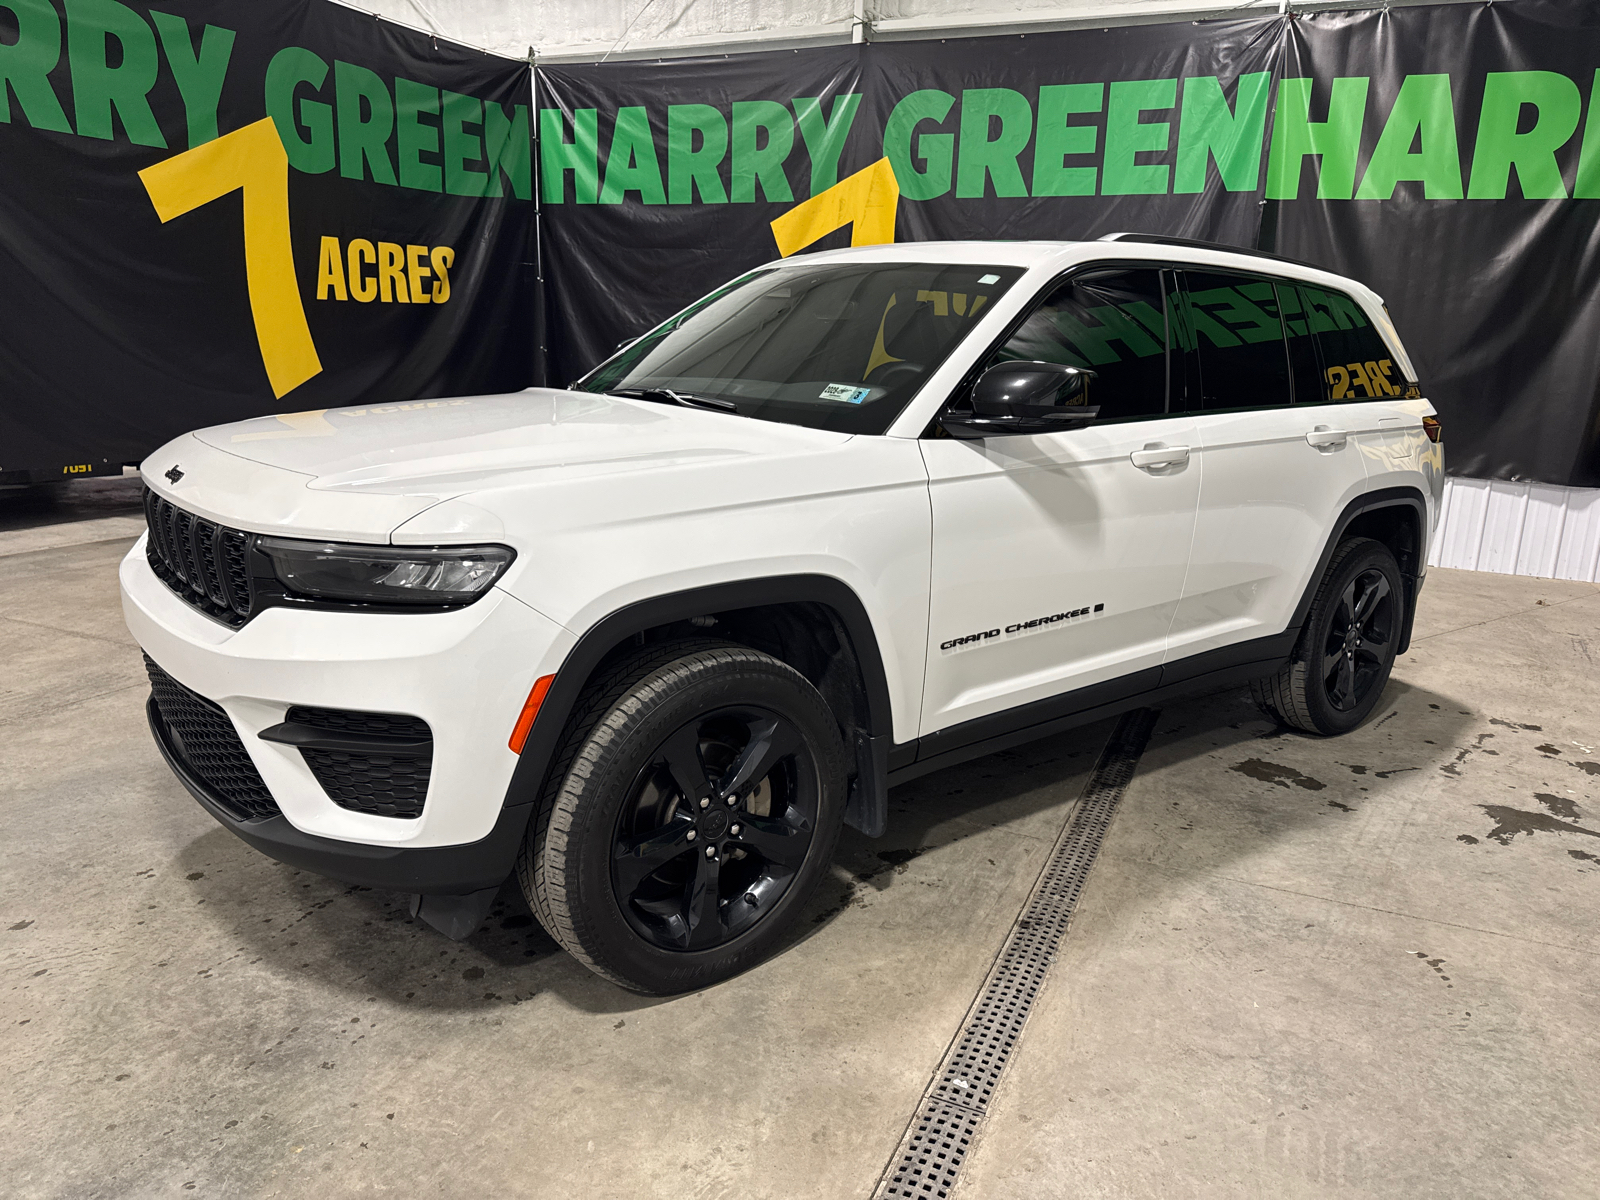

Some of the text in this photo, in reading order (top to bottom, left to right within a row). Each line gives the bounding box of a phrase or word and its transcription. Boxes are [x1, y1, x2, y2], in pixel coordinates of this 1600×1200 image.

[264, 46, 533, 201] GREEN
[539, 71, 1272, 205] HARRY GREEN
[1264, 68, 1600, 200] HAR
[137, 116, 455, 400] 7 ACRES
[940, 606, 1091, 650] GRAND CHEROKEE
